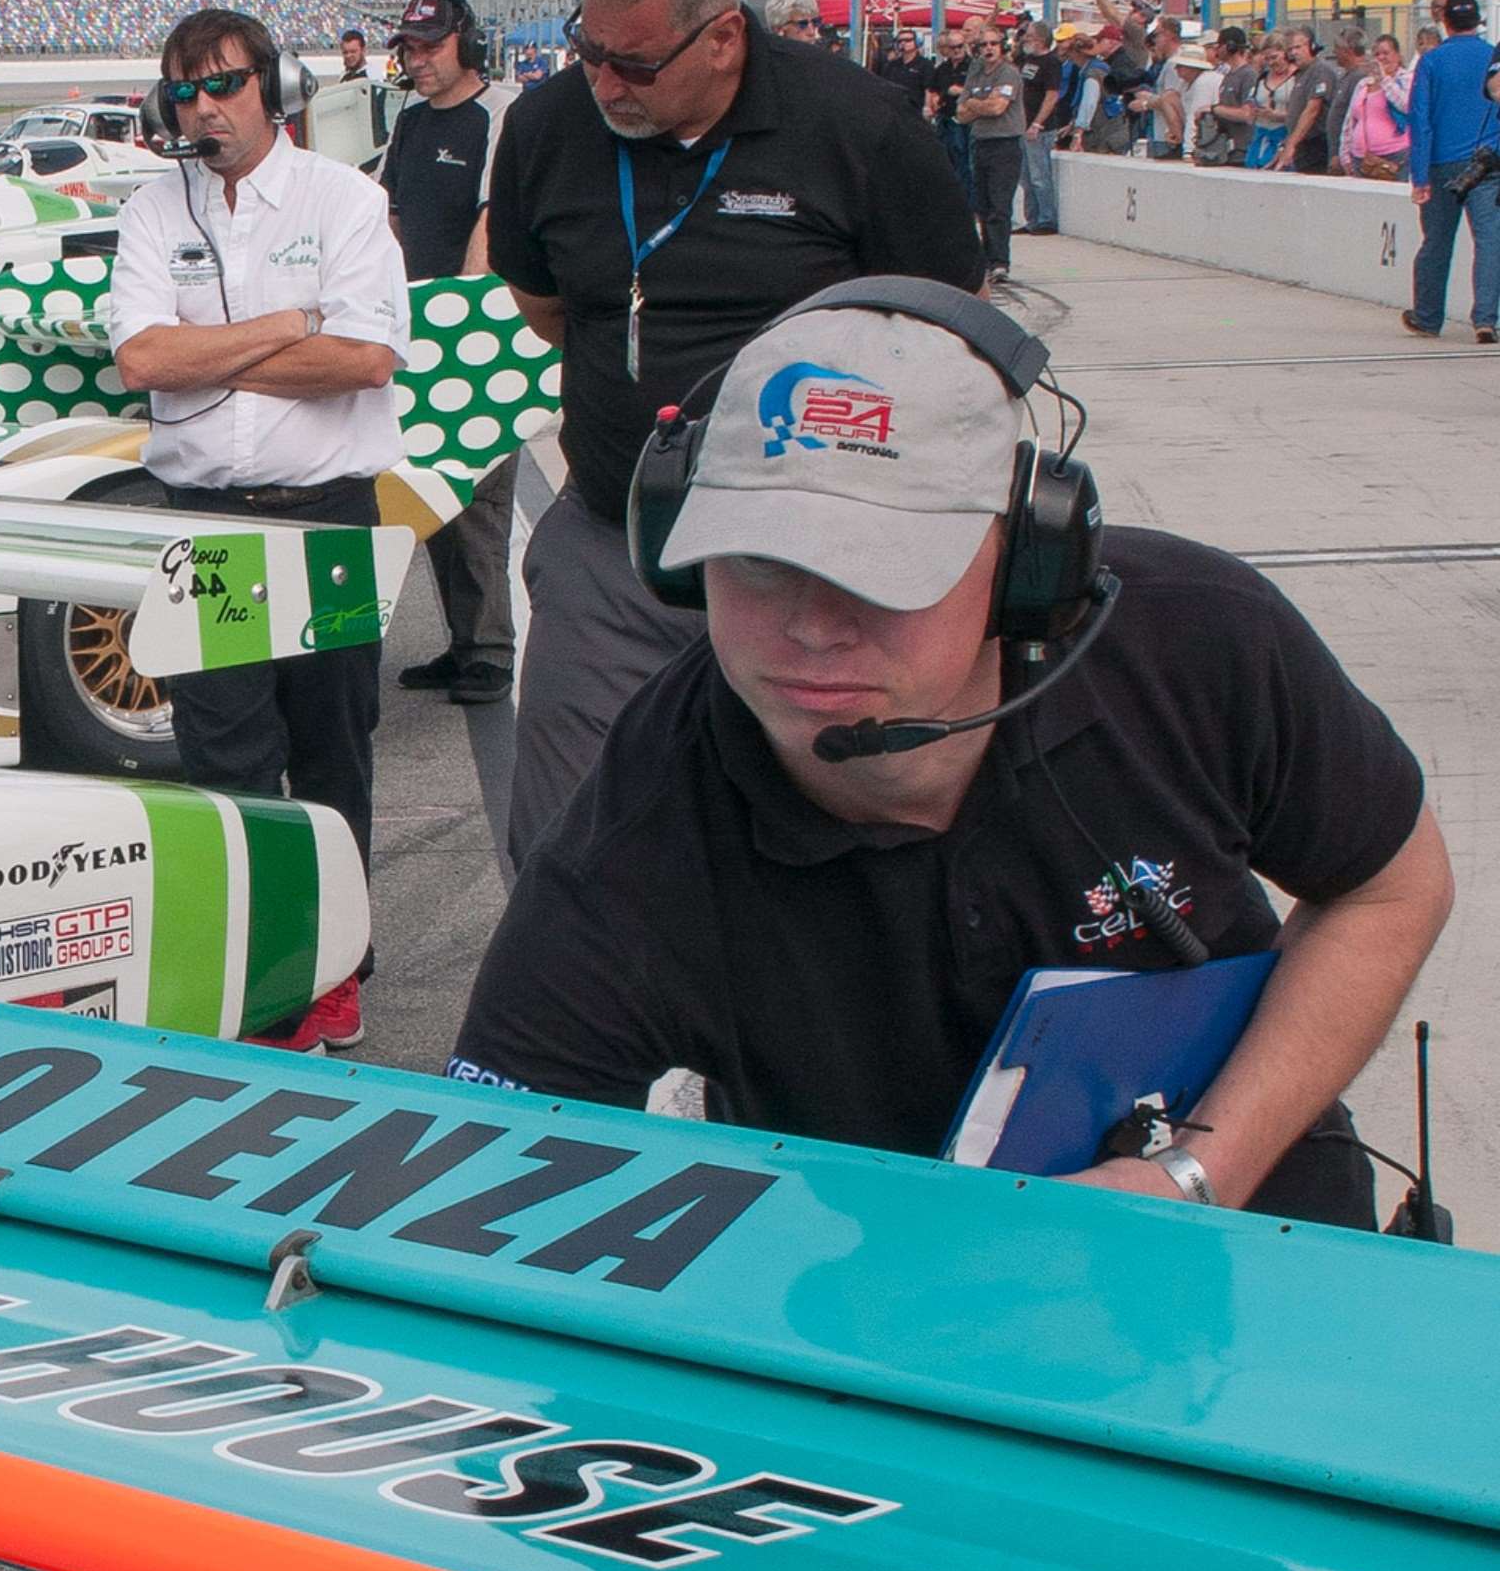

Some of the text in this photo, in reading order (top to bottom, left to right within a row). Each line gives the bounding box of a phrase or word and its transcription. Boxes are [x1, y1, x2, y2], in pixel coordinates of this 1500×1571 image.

[1381, 221, 1396, 267] 24
[800, 423, 876, 440] HOUR
[802, 397, 896, 443] 24
[162, 538, 229, 583] Group
[216, 595, 255, 624] Inc.
[55, 903, 130, 937] GTP
[57, 936, 114, 965] GROUP
[118, 933, 130, 953] C
